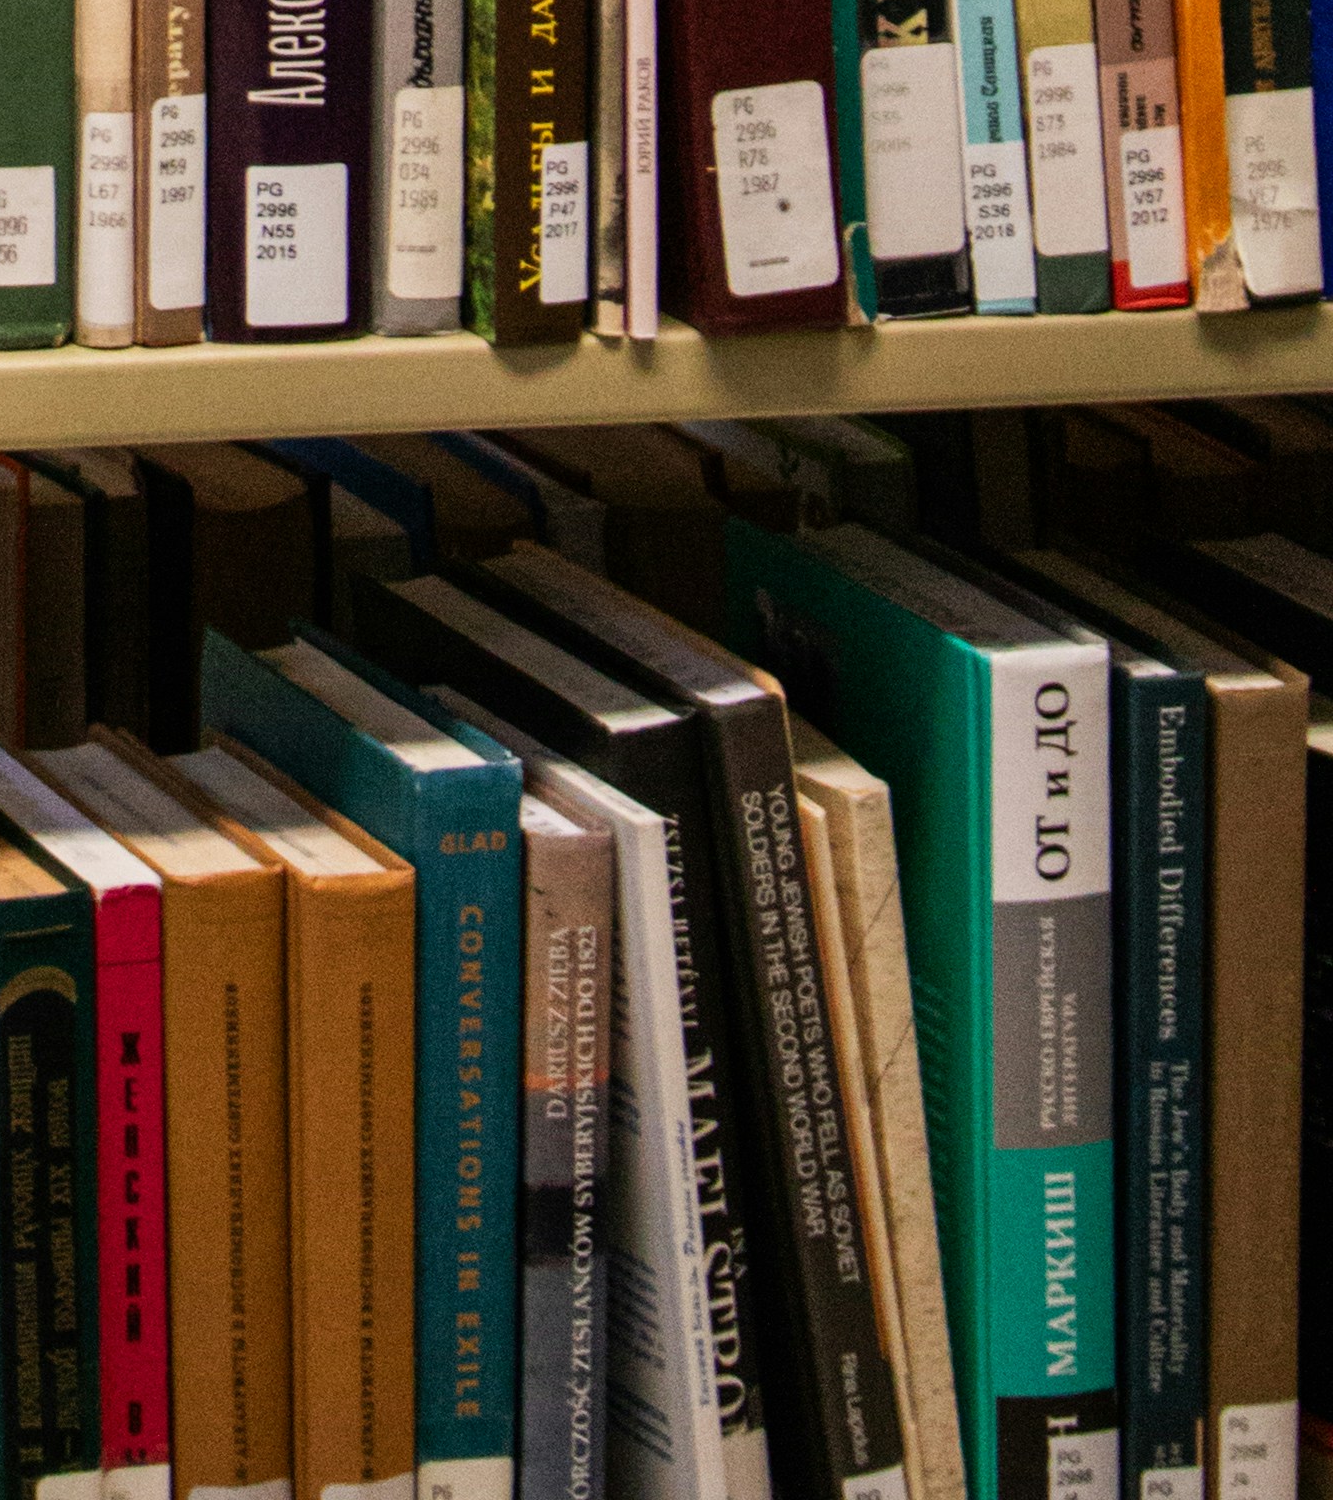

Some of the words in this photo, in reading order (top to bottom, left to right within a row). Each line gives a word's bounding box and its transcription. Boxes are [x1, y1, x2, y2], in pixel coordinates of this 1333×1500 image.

[256, 181, 284, 197] PG
[256, 202, 299, 219] 2996
[969, 162, 998, 179] PG
[256, 245, 298, 261] 2015
[1036, 680, 1080, 759] ДО
[1157, 702, 1188, 855] Embodied
[438, 830, 508, 856] GLAD
[1034, 817, 1072, 884] ОТ
[770, 787, 795, 871] YOUNG
[795, 966, 821, 1042] POETS
[1157, 865, 1180, 1042] Differences
[744, 789, 776, 905] SOLDIERS
[773, 989, 804, 1089] SECOND
[789, 1093, 817, 1180] WORLD
[455, 906, 485, 1231] CONVERSATIONS
[547, 1007, 571, 1120] DARIUSZ
[1044, 1169, 1079, 1378] МАРКИШ
[455, 1313, 482, 1420] EXILE
